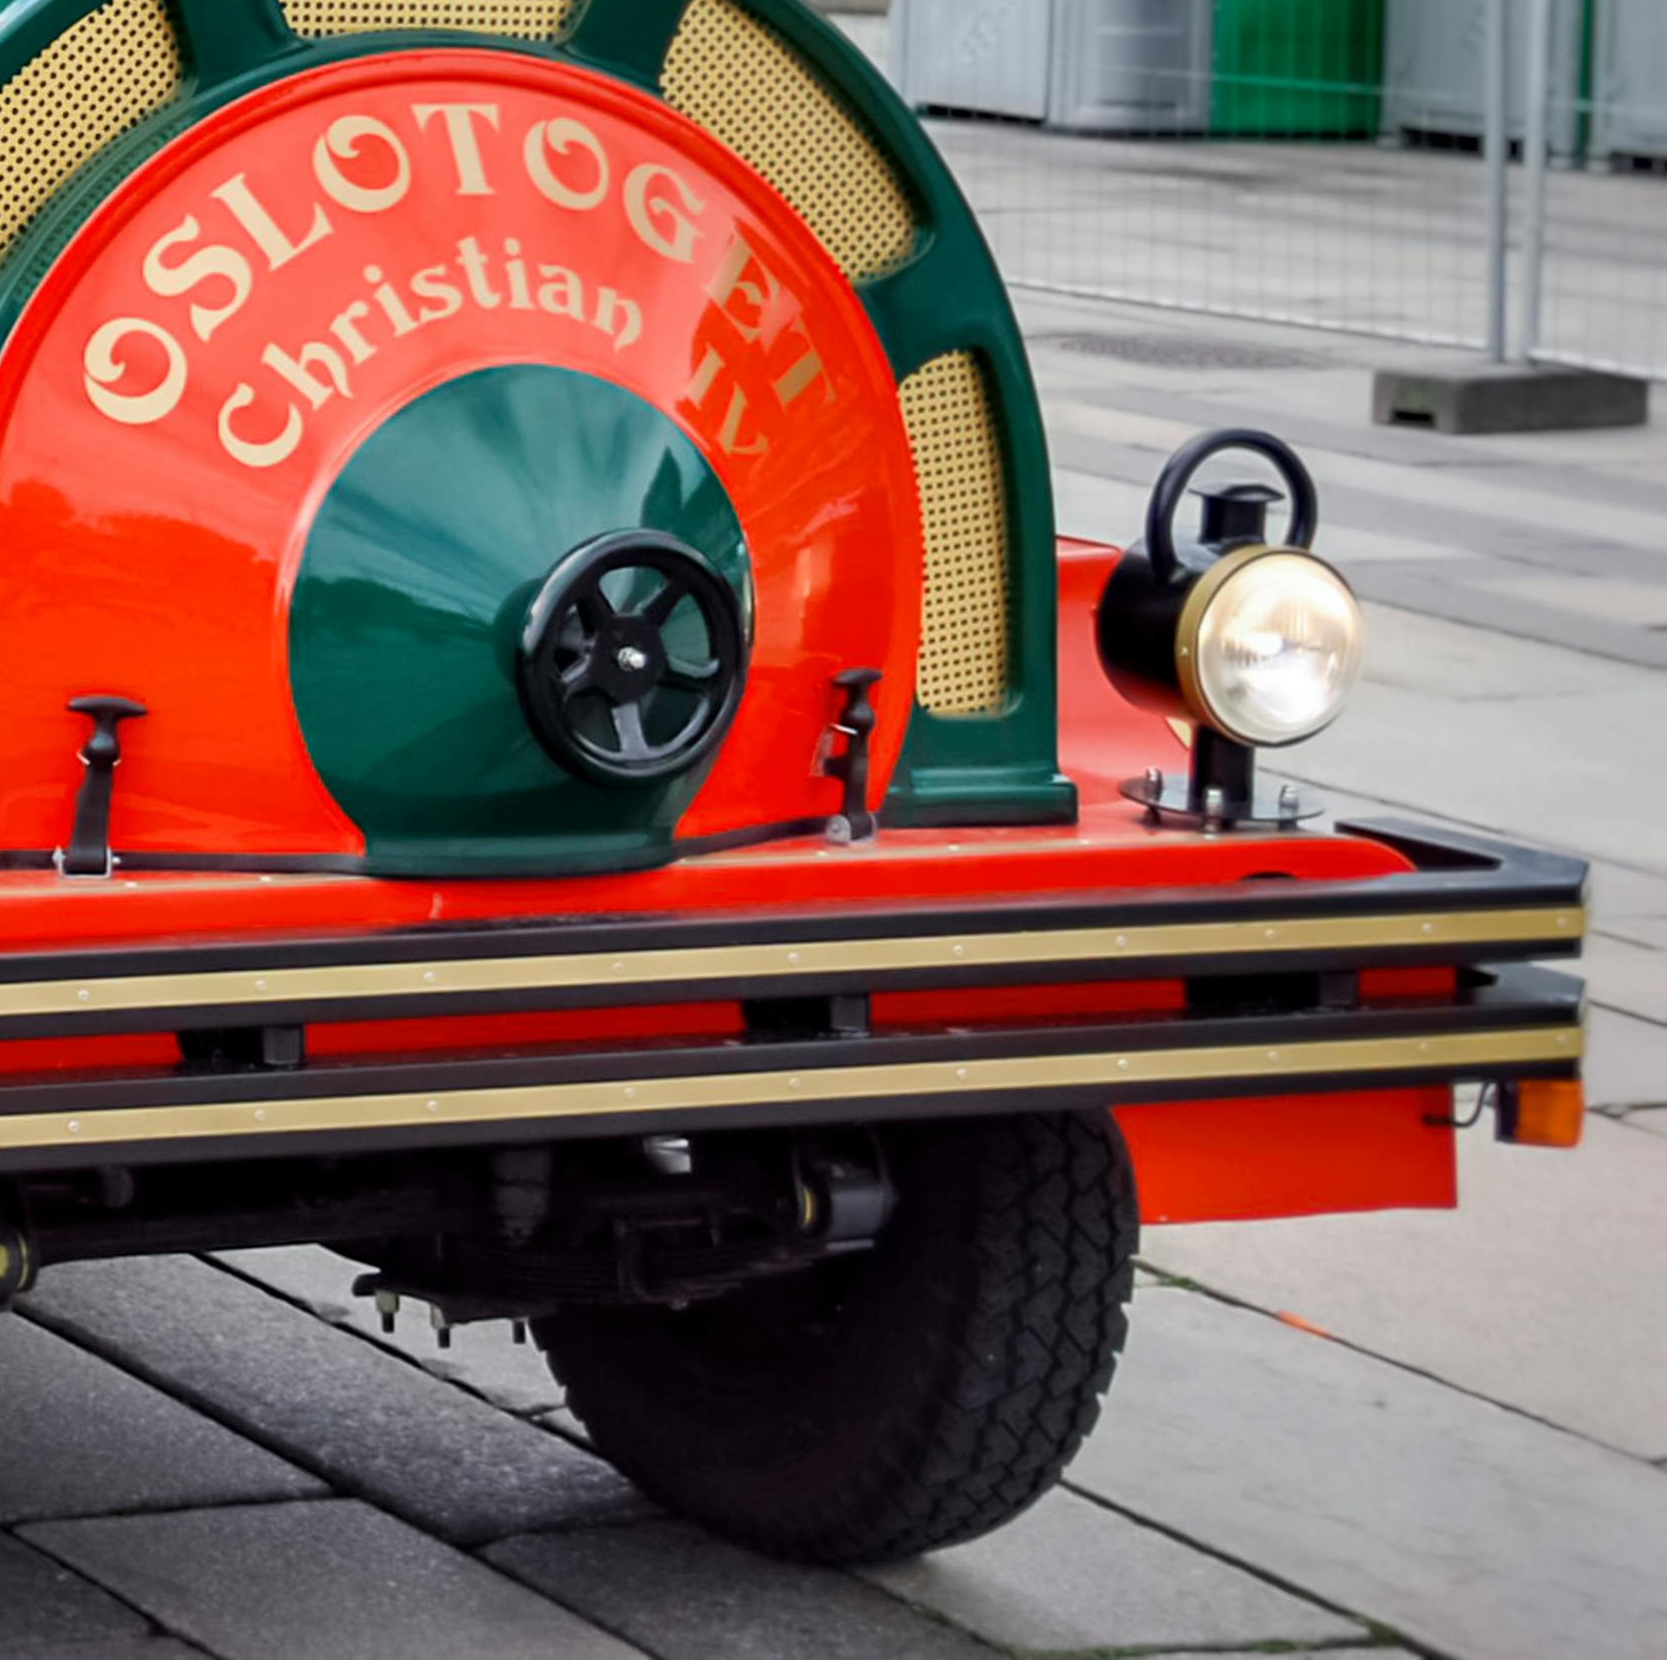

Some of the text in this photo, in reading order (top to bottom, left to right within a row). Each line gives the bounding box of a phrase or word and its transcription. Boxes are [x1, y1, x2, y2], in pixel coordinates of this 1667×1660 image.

[83, 104, 836, 424] OSLOTOGET
[218, 237, 769, 467] Christian IV
